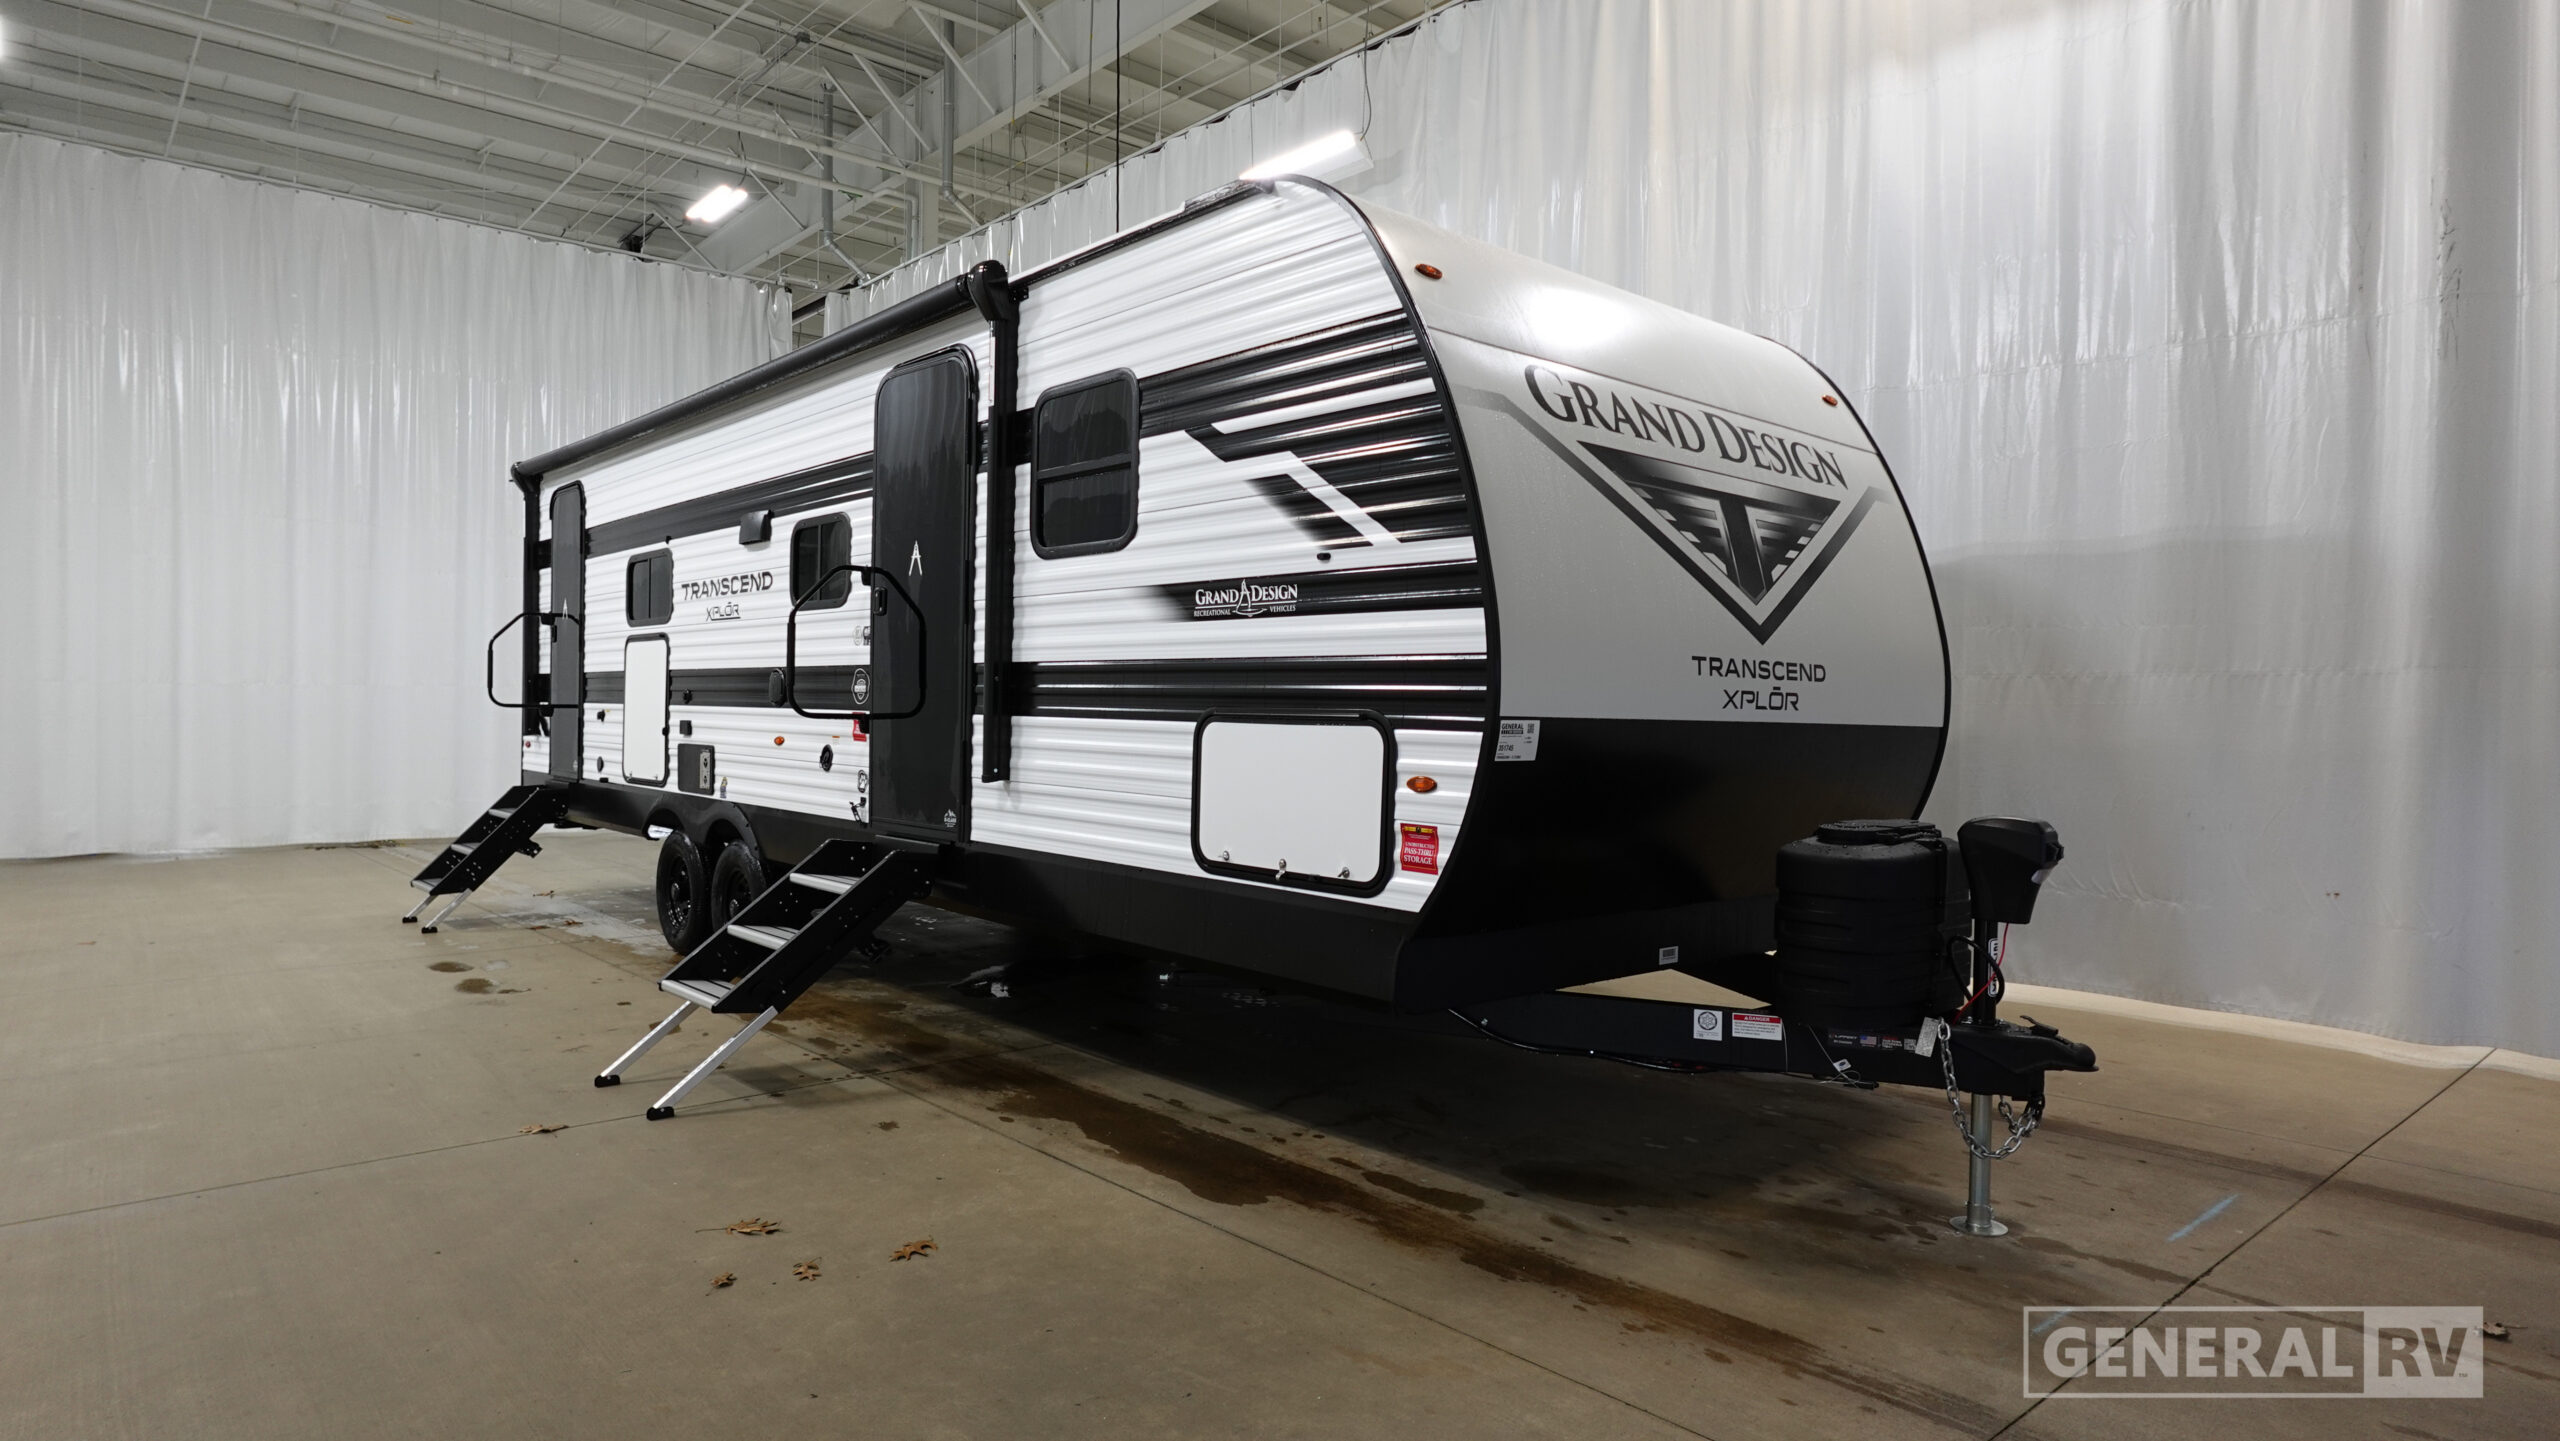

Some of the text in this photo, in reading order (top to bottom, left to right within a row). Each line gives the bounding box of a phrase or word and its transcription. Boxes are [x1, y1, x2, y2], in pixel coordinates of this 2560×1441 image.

[1524, 364, 1849, 490] GRAND DESIGN
[681, 571, 773, 600] TRANSCEND
[1195, 584, 1298, 605] GRAND DESIGN
[1193, 605, 1296, 617] RECREATIONAL VEHICLES
[1691, 655, 1827, 683] TRANSCEND
[1404, 847, 1434, 857] PASS-THRU
[1404, 855, 1432, 865] STORAGE
